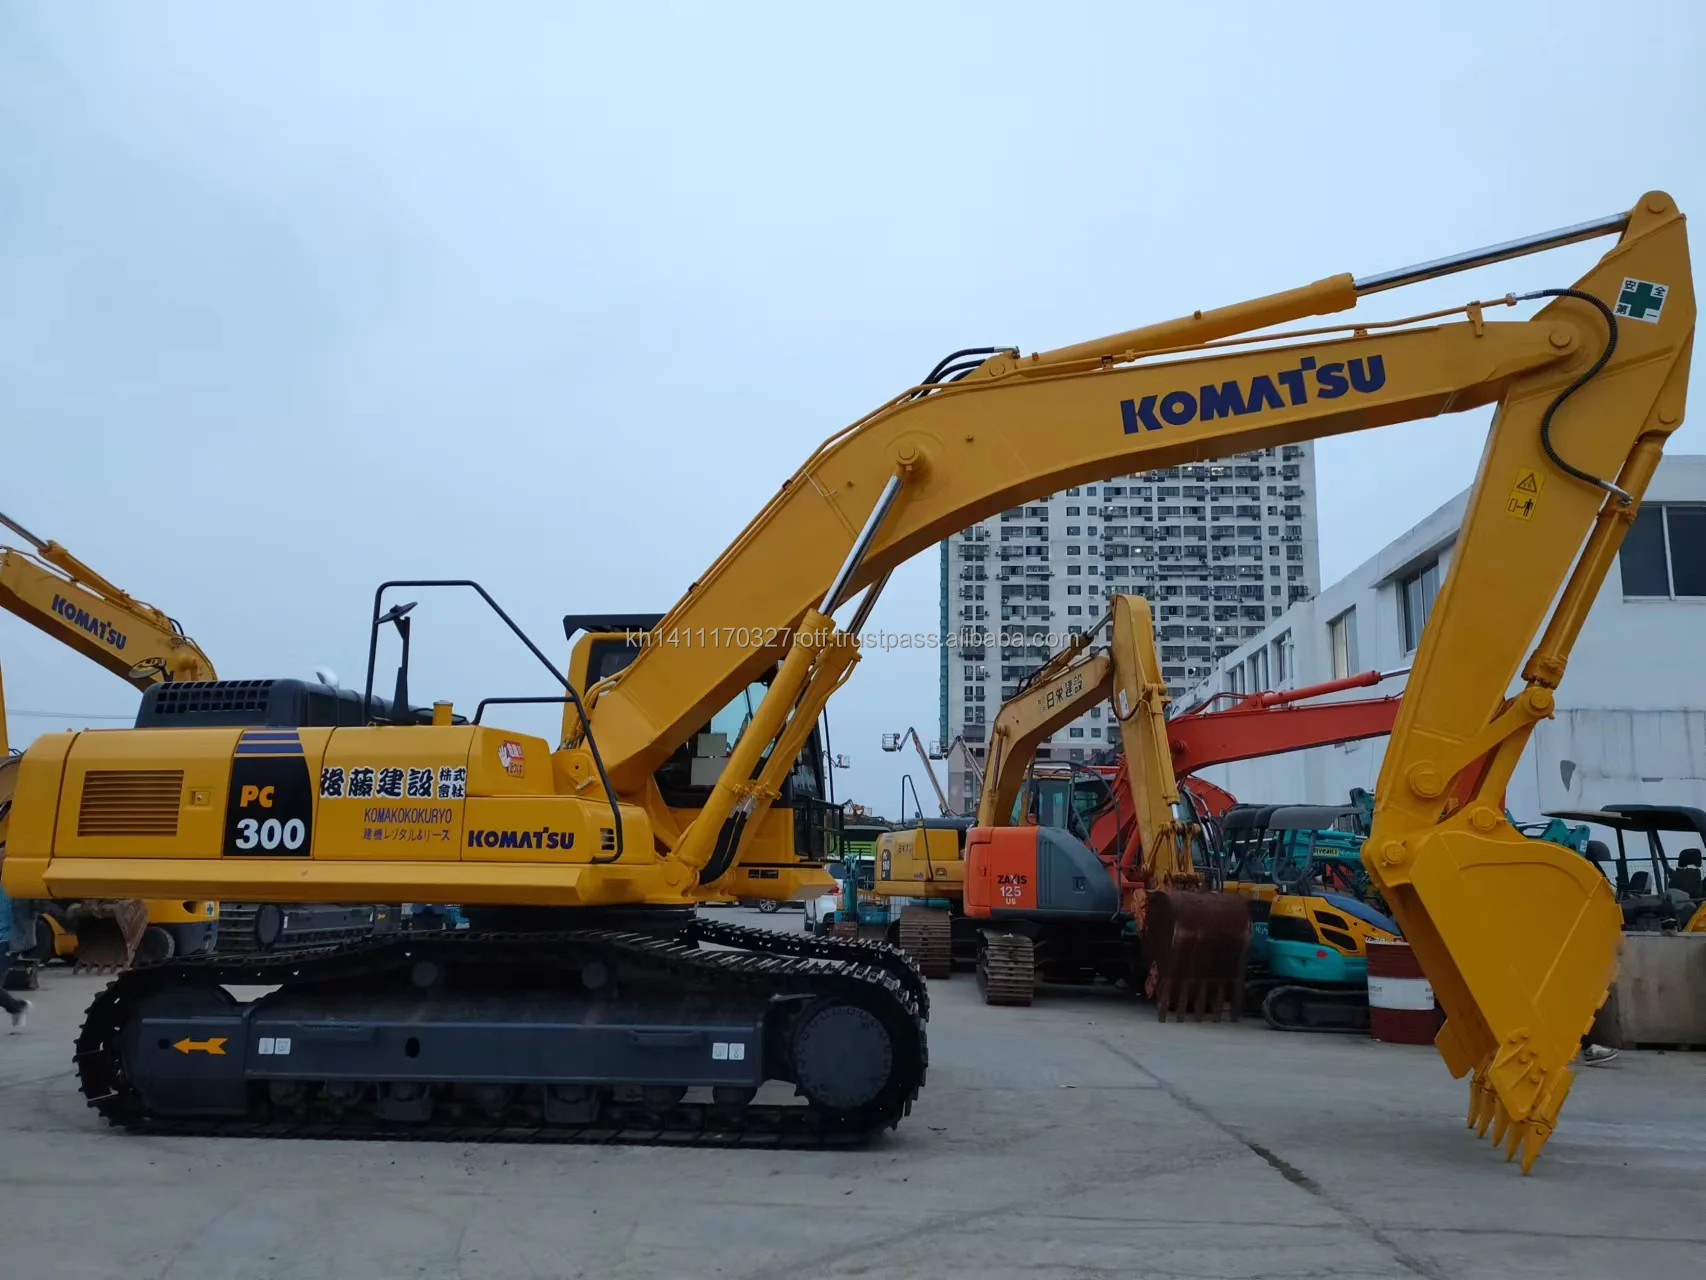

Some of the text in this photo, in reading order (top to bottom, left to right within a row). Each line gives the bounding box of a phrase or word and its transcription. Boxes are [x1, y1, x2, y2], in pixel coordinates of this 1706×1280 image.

[1120, 354, 1386, 435] KOMATSU
[51, 594, 127, 650] KOMATSU
[240, 784, 275, 808] PC
[235, 818, 306, 850] 300
[467, 827, 575, 850] KOMATSU
[997, 874, 1028, 885] ZAXIS
[999, 885, 1022, 897] 125
